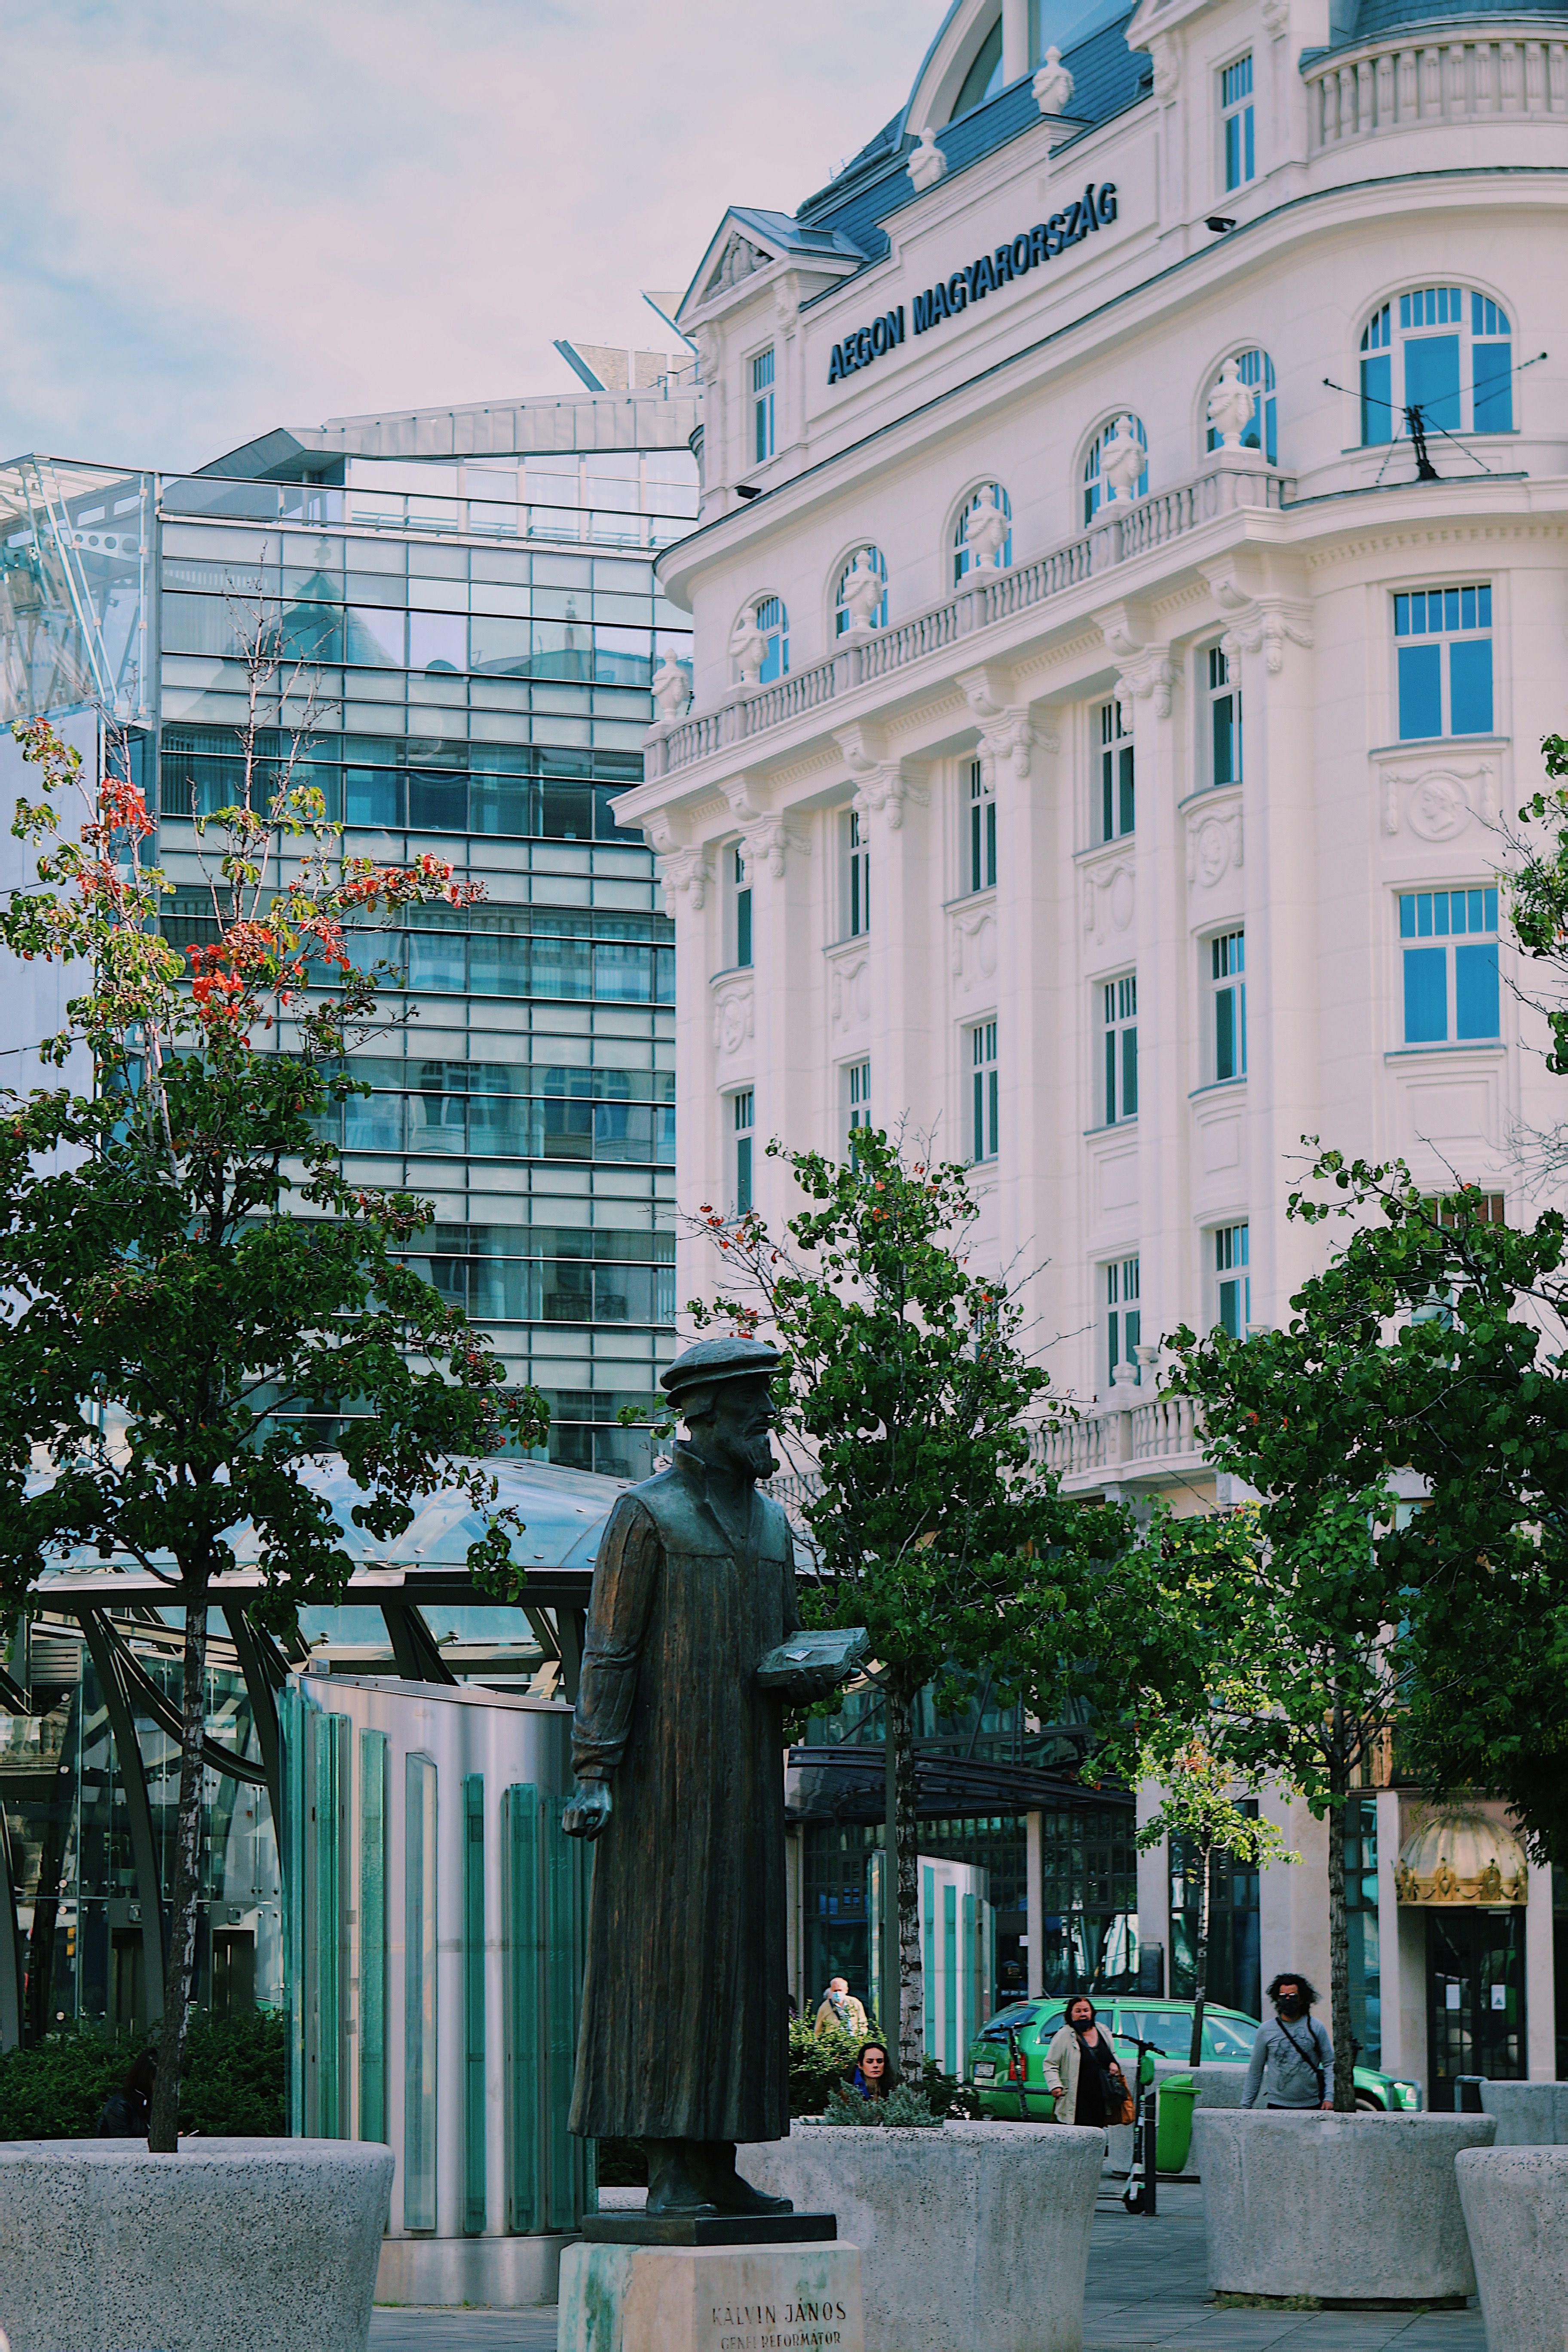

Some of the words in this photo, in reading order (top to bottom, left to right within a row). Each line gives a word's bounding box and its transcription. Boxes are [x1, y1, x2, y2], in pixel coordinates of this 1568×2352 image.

[827, 305, 906, 385] AEGON
[913, 183, 1117, 335] MAGYARORSZÁG
[784, 2297, 846, 2323] JÁNOS
[761, 2328, 840, 2348] REFORMÁTOR
